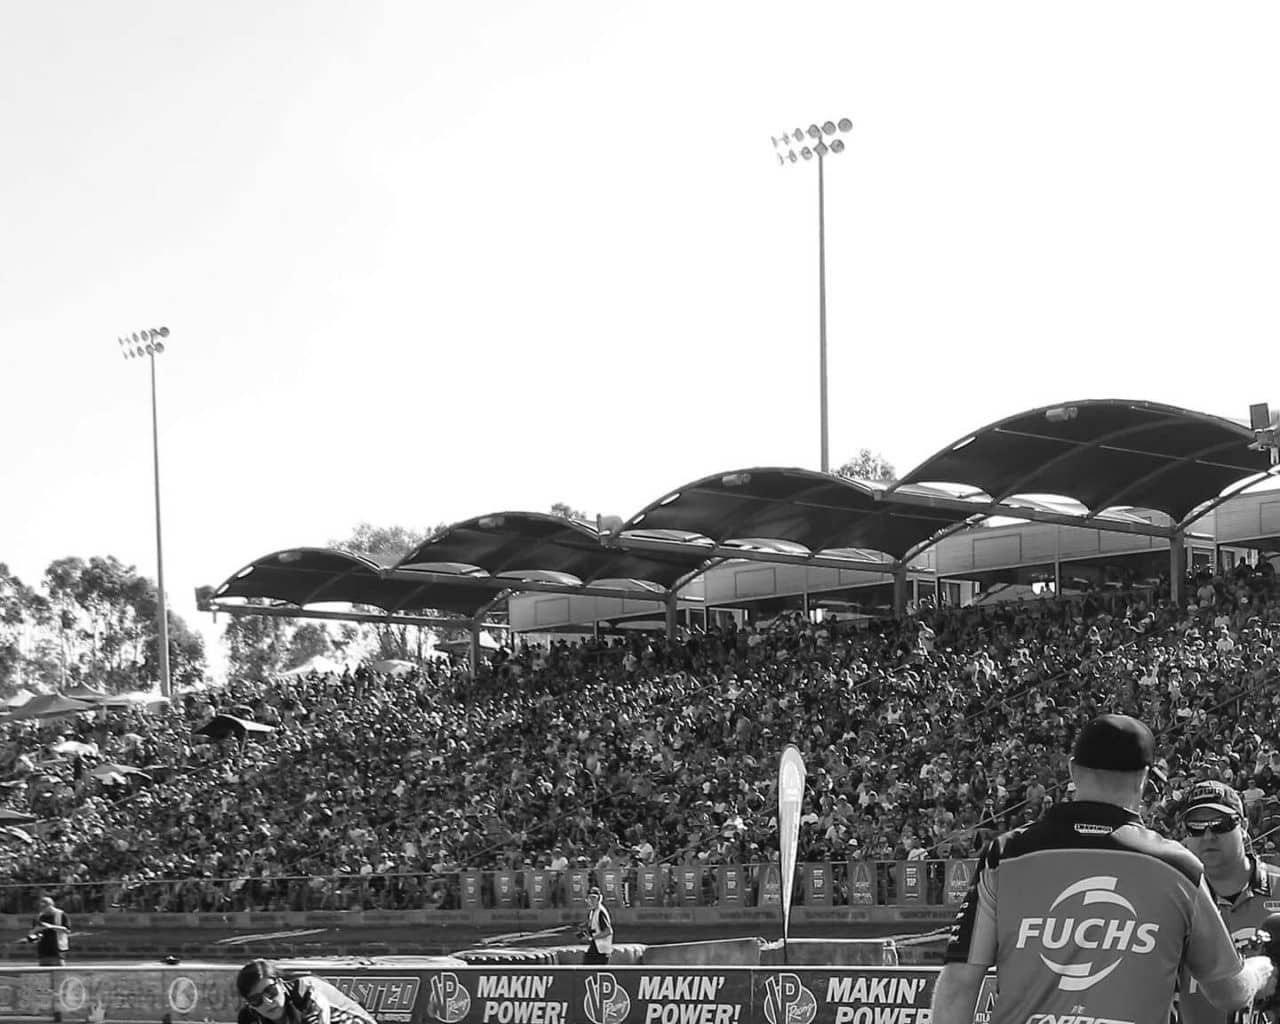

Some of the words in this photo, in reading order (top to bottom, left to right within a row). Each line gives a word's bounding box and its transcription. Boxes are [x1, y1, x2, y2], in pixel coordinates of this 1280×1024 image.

[1016, 917, 1160, 953] FUCHS
[477, 975, 554, 998] MAKIN'
[638, 975, 726, 1001] MAKIN'
[826, 977, 927, 1004] MAKIN'
[483, 1001, 569, 1024] POWER!
